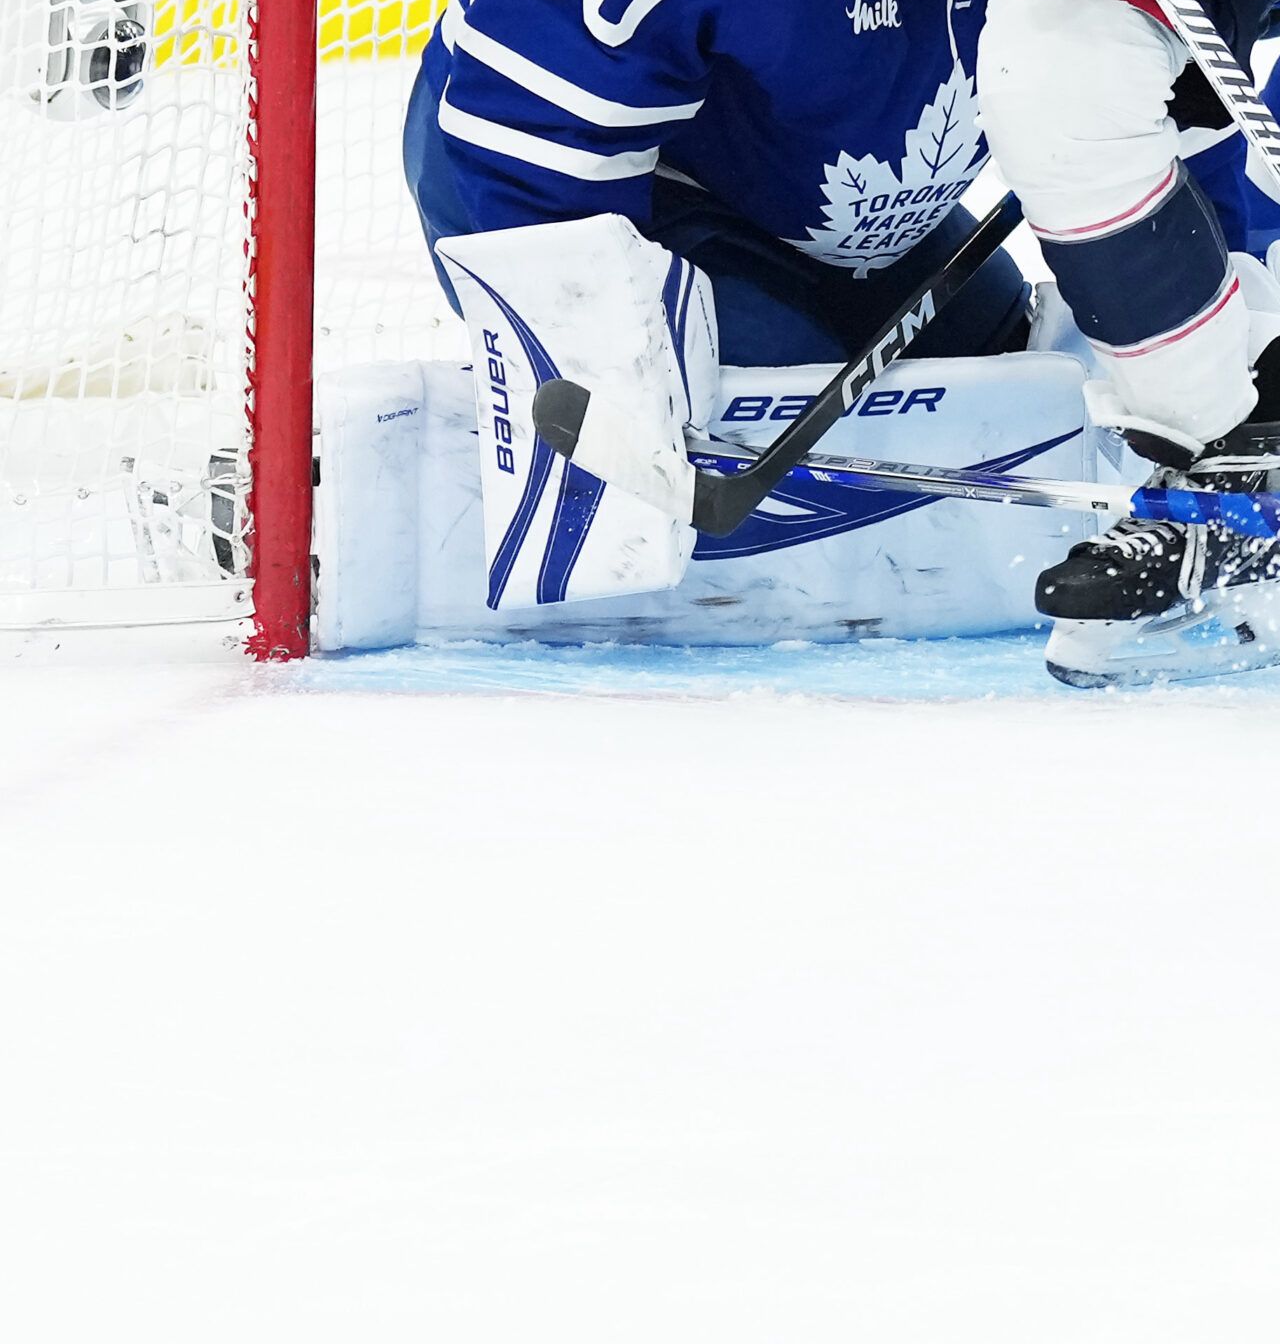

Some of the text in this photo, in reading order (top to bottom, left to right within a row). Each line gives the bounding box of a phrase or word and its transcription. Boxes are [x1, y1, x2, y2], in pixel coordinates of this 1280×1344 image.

[848, 179, 972, 218] TORONTO
[854, 201, 949, 233] MAPLE
[838, 223, 931, 250] LEAFS
[841, 289, 936, 411] CCM
[720, 387, 946, 422] BAER
